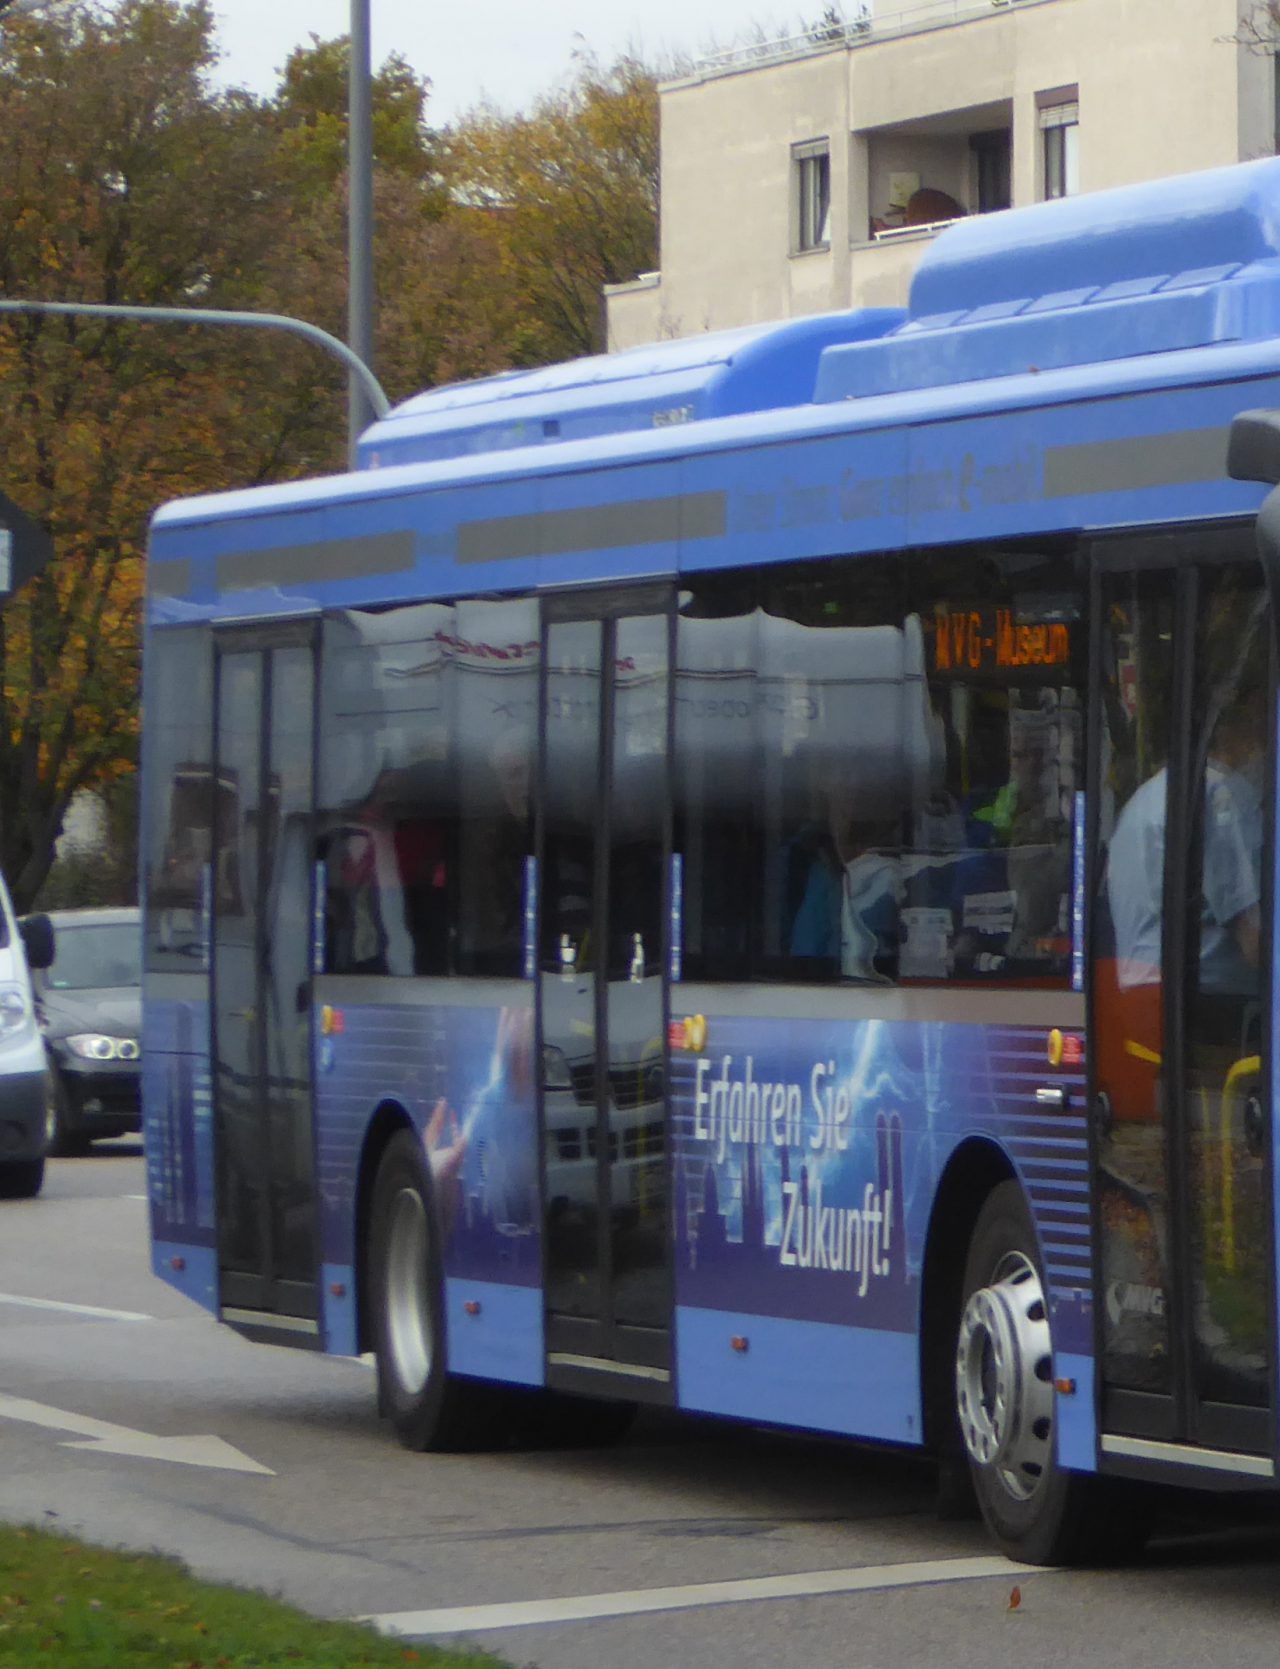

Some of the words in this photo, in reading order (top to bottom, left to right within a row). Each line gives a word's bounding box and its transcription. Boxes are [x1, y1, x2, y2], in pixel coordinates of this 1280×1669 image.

[695, 1055, 802, 1164] Erfahren
[809, 1060, 850, 1150] Sie
[779, 1179, 892, 1297] Zukunft!
